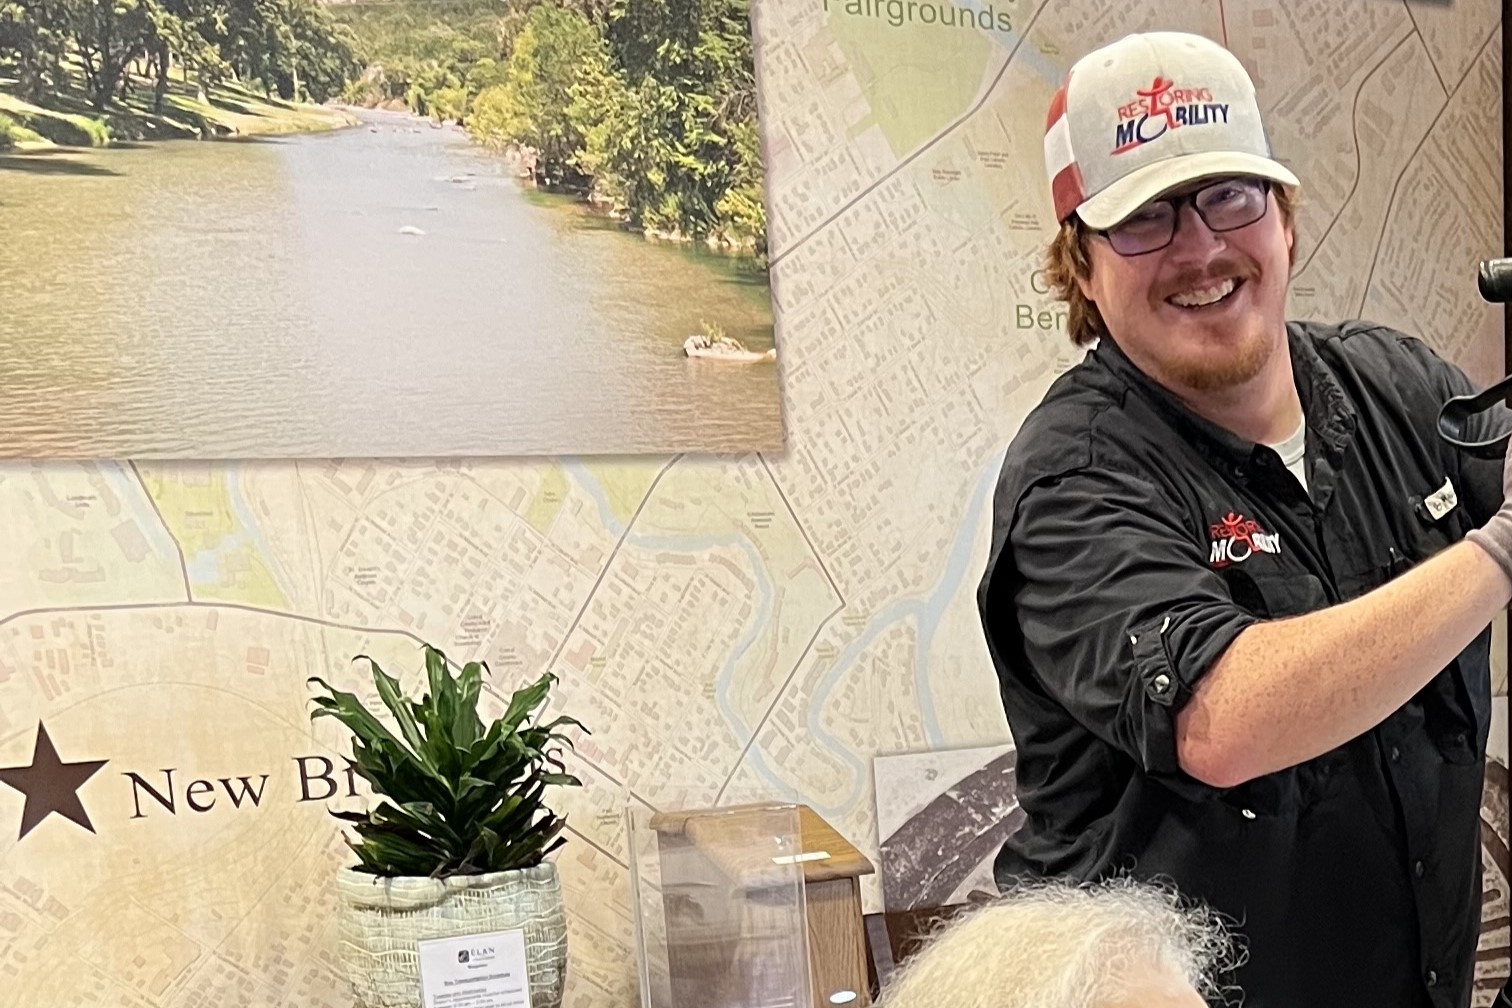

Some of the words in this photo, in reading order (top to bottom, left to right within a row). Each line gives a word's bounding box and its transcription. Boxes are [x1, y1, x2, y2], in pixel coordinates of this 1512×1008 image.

[1117, 76, 1213, 121] RESTORING
[1115, 104, 1229, 149] MOBILITY
[121, 768, 270, 819] New
